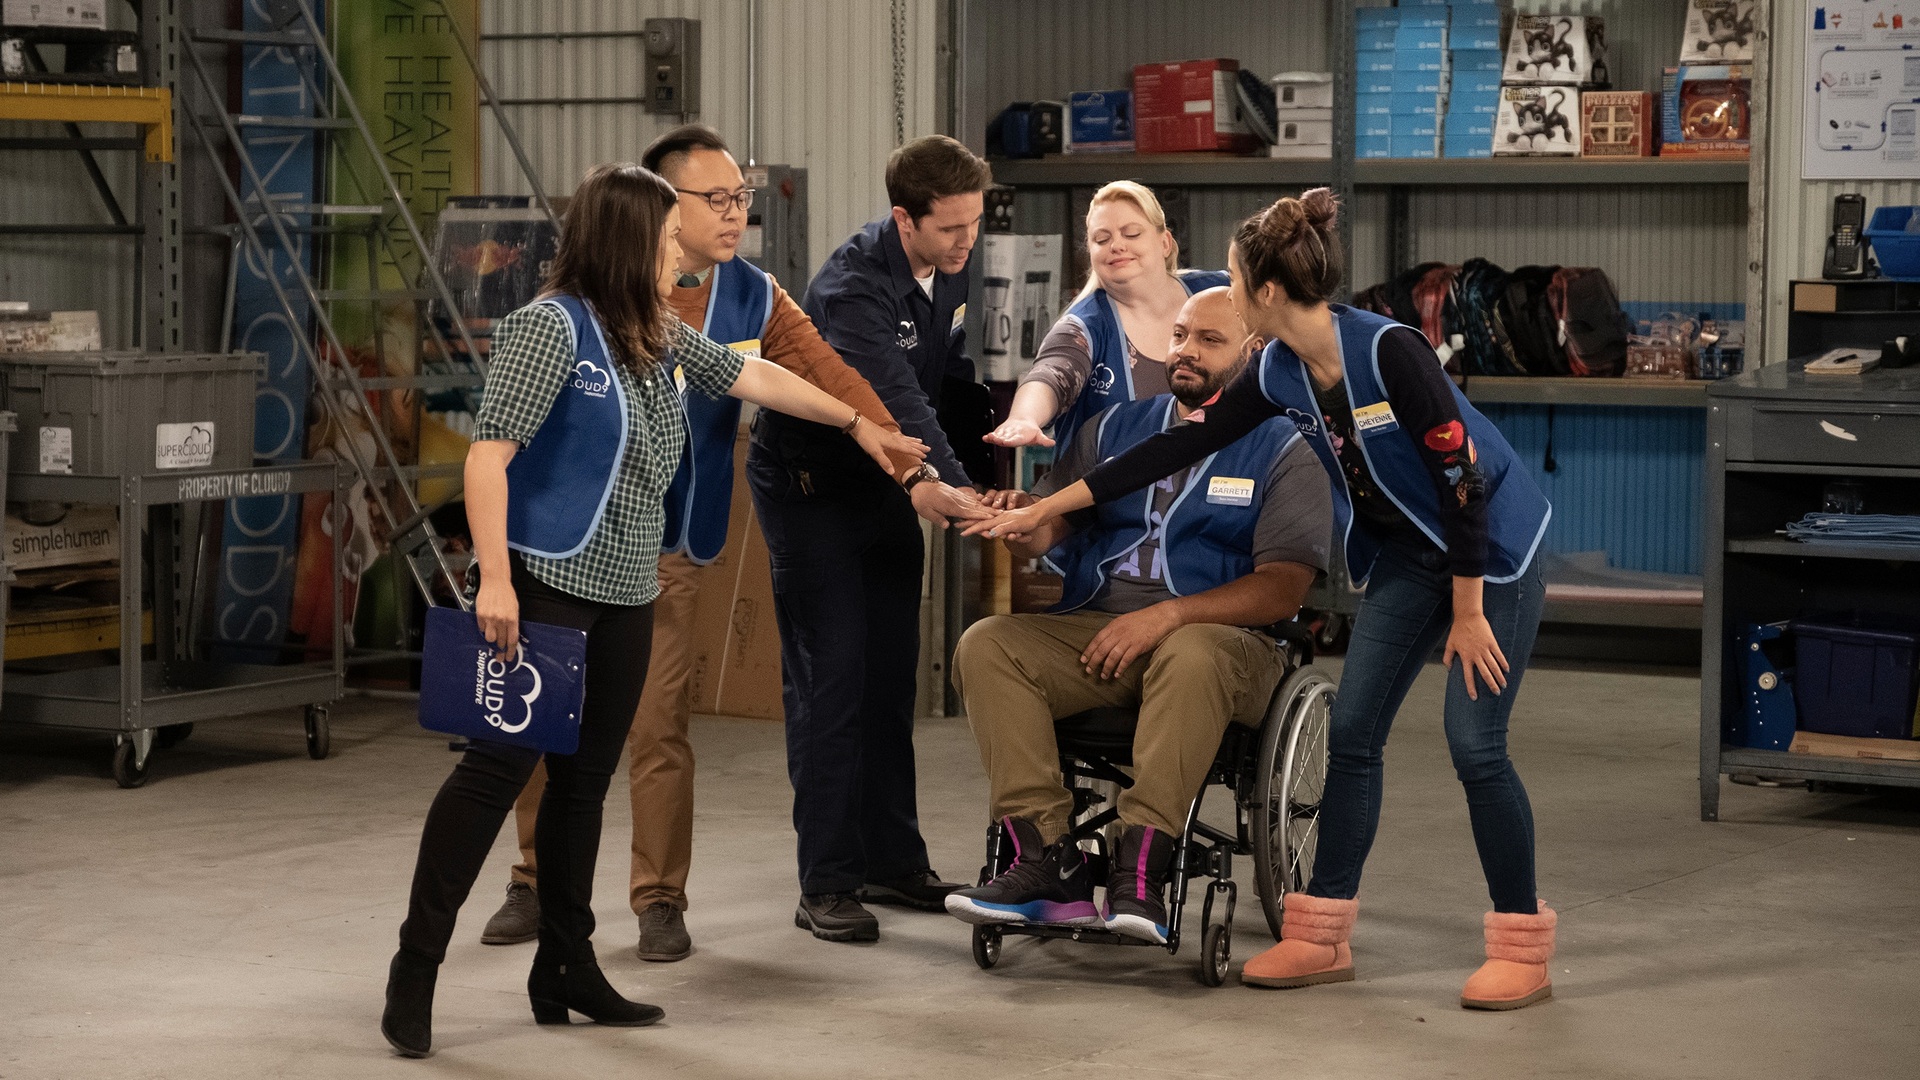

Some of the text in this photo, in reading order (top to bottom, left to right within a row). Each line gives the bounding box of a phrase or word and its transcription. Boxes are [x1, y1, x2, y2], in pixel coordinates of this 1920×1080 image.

[1358, 413, 1393, 428] CHEYENNE
[178, 472, 291, 500] PROPERTY OF CLOUD9
[1211, 486, 1250, 496] GARRETT
[12, 527, 110, 557] simplehuman
[475, 649, 488, 705] Superstore
